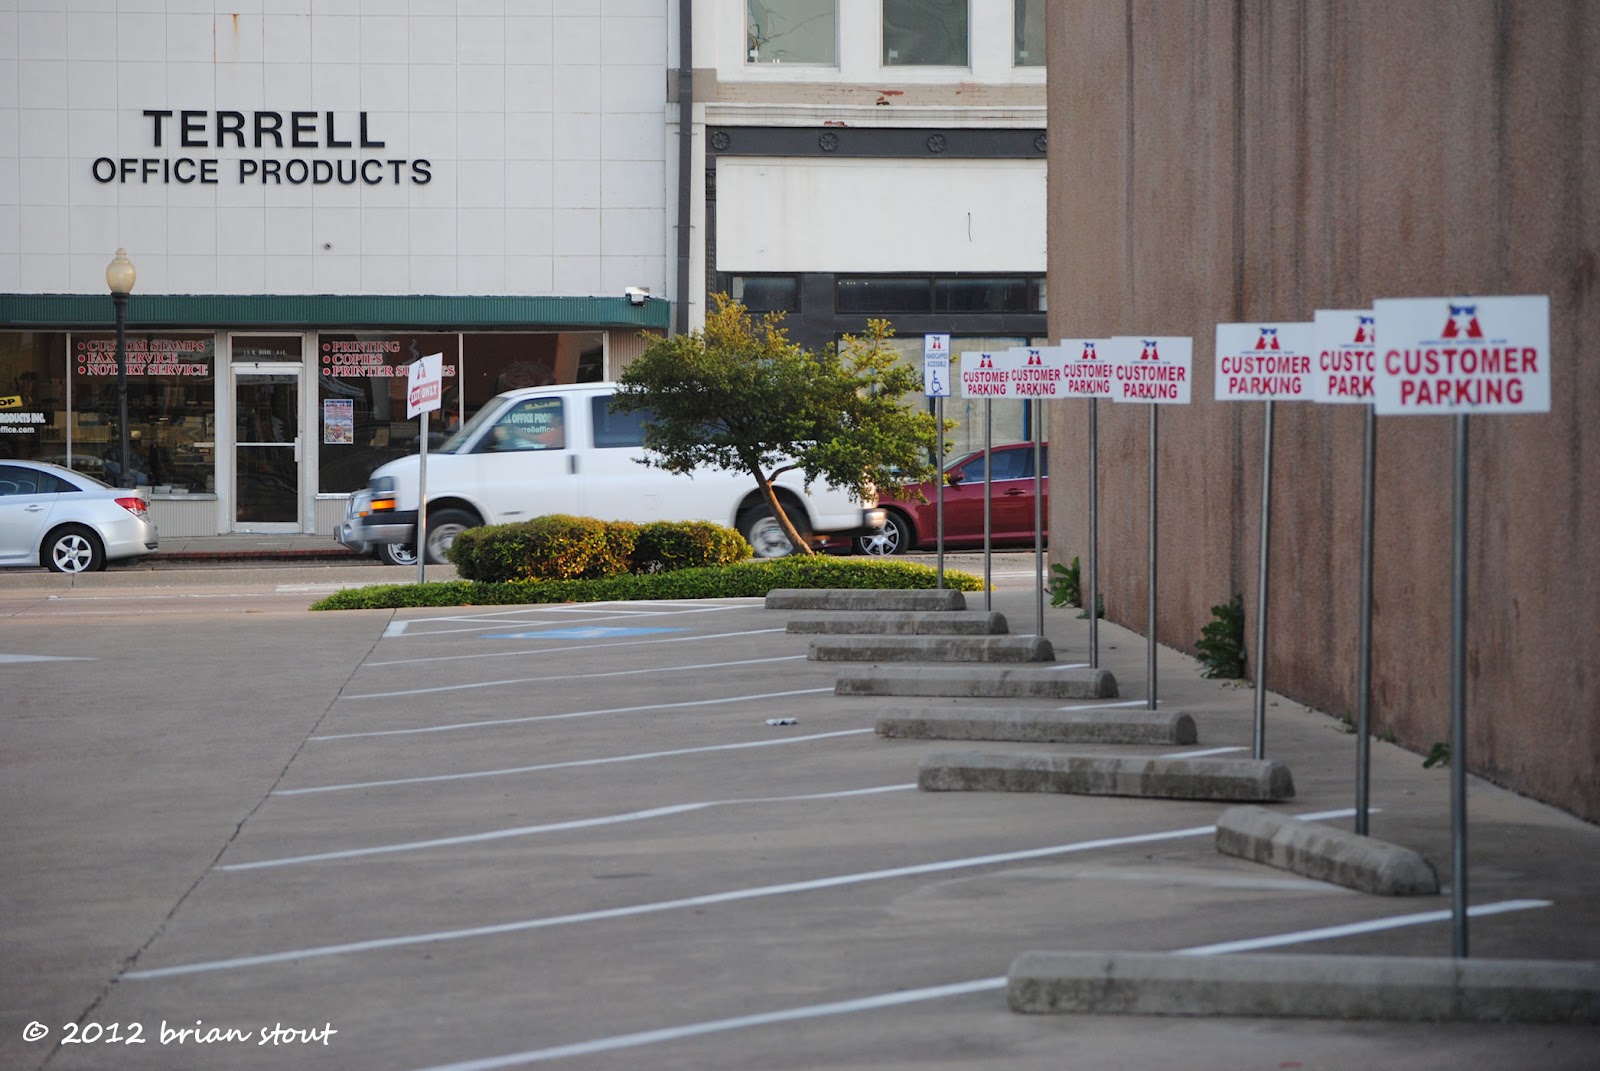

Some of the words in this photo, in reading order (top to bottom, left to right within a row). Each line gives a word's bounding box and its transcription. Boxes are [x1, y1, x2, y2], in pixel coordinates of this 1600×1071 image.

[143, 110, 385, 148] TERRELL
[92, 157, 218, 184] OFFICE
[239, 159, 432, 185] PRODUCTS
[87, 340, 148, 352] CUSOM
[150, 340, 205, 352] STAMPS
[332, 341, 400, 353] PRINTING
[87, 352, 116, 364] FAX
[122, 352, 178, 364] ERVICE
[332, 353, 383, 365] COPIES
[1319, 350, 1375, 372] CUSTO
[1384, 347, 1538, 376] CUSTOMER
[87, 364, 144, 376] NOTRY
[148, 364, 208, 376] SERVICE
[332, 365, 394, 377] PRINTER
[1221, 356, 1311, 374] CUSTOMER
[1011, 369, 1061, 382] CUSTOMER
[1116, 365, 1186, 382] CUSTOMER
[421, 384, 438, 398] ONLY
[968, 384, 1007, 395] PARKING
[1016, 383, 1056, 395] PARKING
[1068, 379, 1110, 394] PARKING
[1123, 382, 1178, 399] PARKING
[1229, 376, 1302, 395] PARKING
[1328, 375, 1375, 396] PARK
[1400, 378, 1524, 406] PARKING
[0, 398, 15, 406] OP
[0, 412, 30, 423] RODUCTS
[0, 425, 35, 433] ffice.com
